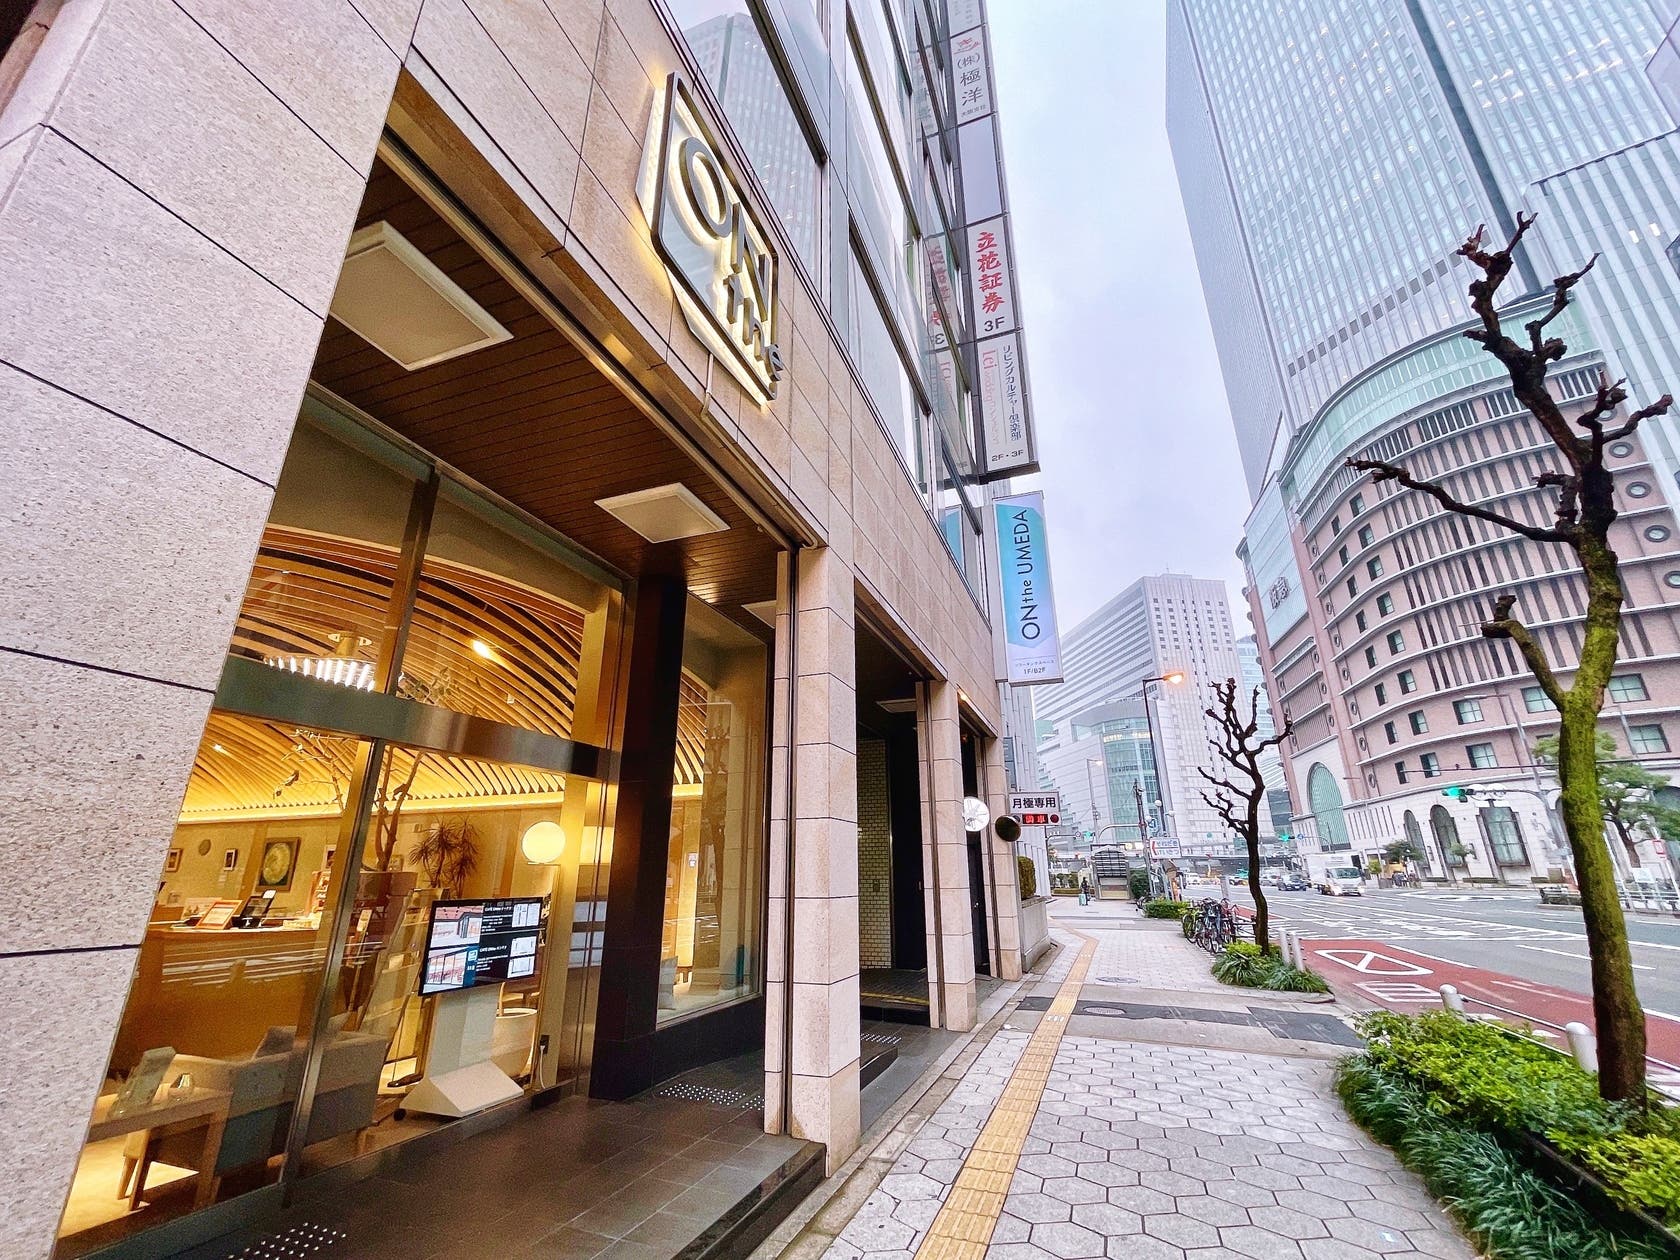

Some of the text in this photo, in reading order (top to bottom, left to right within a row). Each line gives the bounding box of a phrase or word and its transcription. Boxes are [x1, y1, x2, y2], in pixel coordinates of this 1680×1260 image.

[679, 136, 769, 323] ON
[976, 231, 1005, 314] 立花証券
[984, 316, 1005, 332] 3F
[1012, 509, 1033, 575] UMEDA
[1012, 797, 1056, 809] 月極専用
